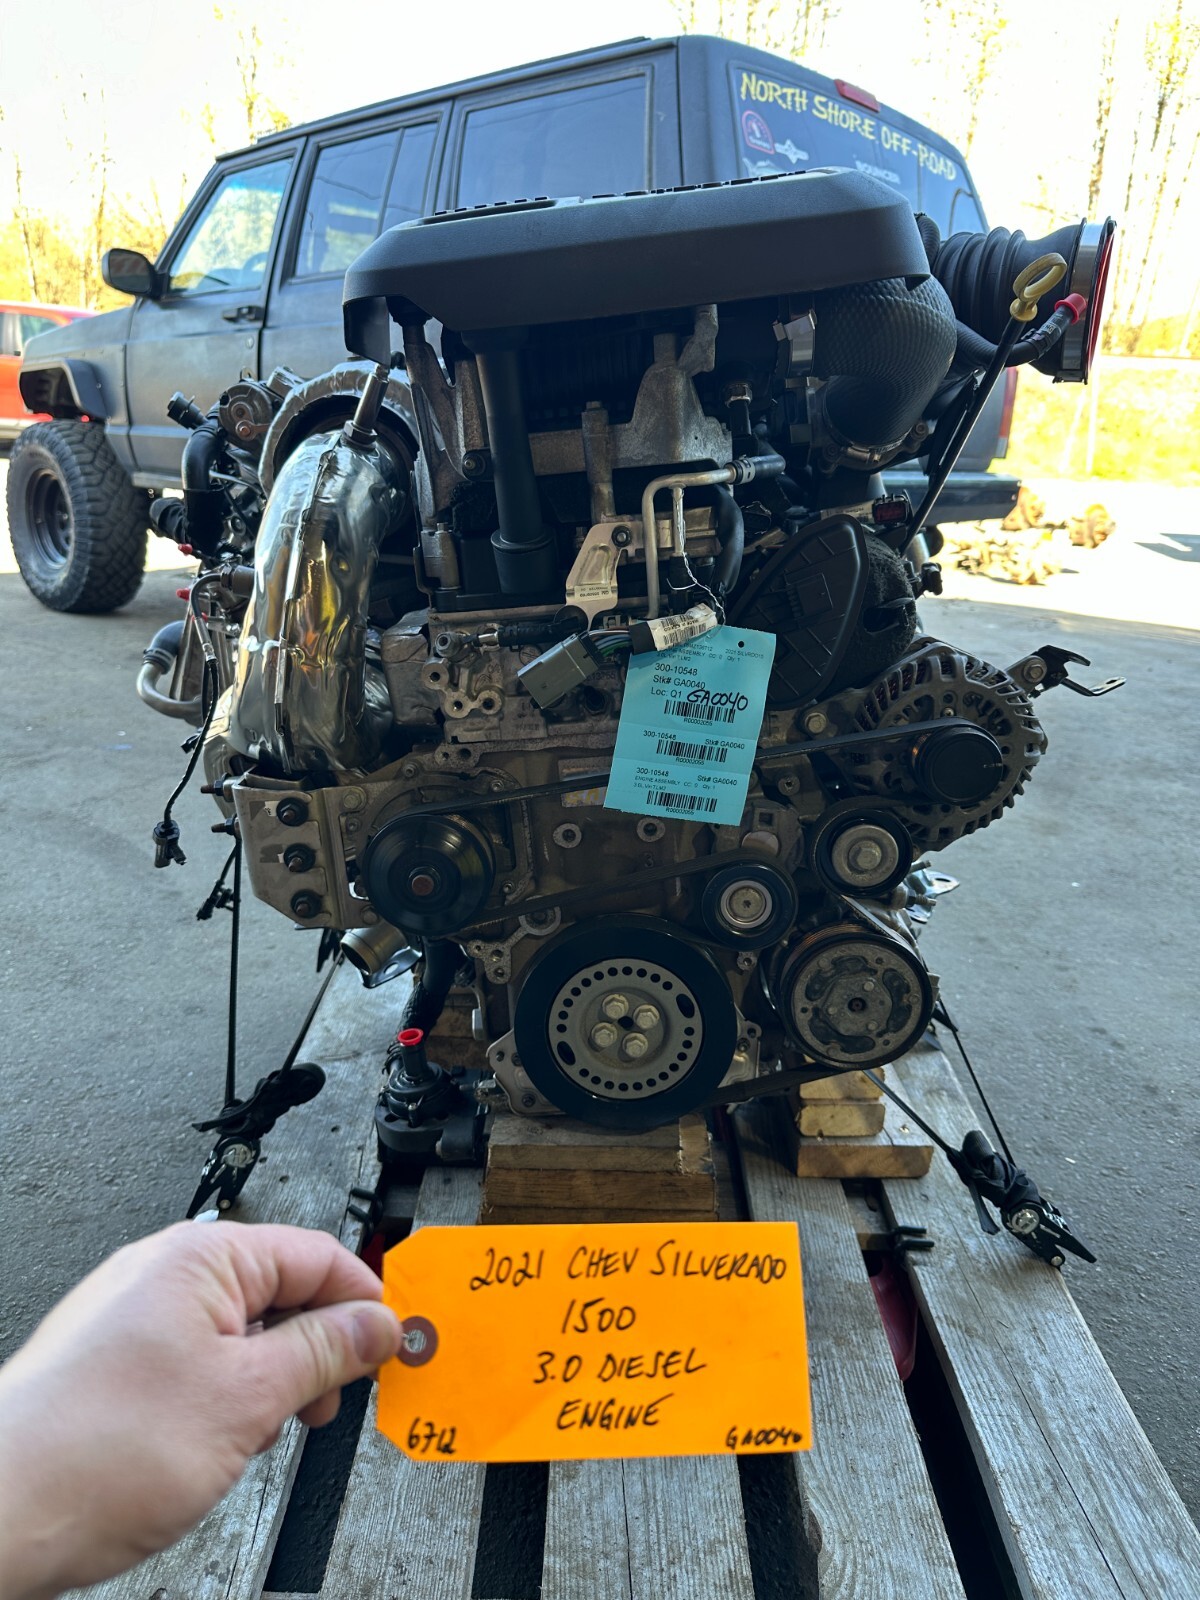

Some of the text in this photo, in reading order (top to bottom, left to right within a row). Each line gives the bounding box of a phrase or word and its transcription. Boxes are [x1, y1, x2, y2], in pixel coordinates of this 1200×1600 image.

[741, 72, 808, 112] NORTH
[812, 95, 876, 140] SHORE
[881, 127, 957, 181] OFF-ROAD
[655, 663, 698, 676] 300-10548
[651, 687, 669, 697] Loc:
[653, 675, 706, 690] Stk# GA0040
[687, 689, 749, 711] GA0040
[643, 730, 745, 750] 300-10548 Stk# GA0040
[636, 767, 737, 786] 300-10548 Stk# GA0040
[469, 1239, 787, 1290] 2021 CHEV SILVERADO
[561, 1298, 636, 1334] 1500
[533, 1347, 707, 1384] 3.0 DIESEL
[556, 1393, 674, 1430] ENGINE
